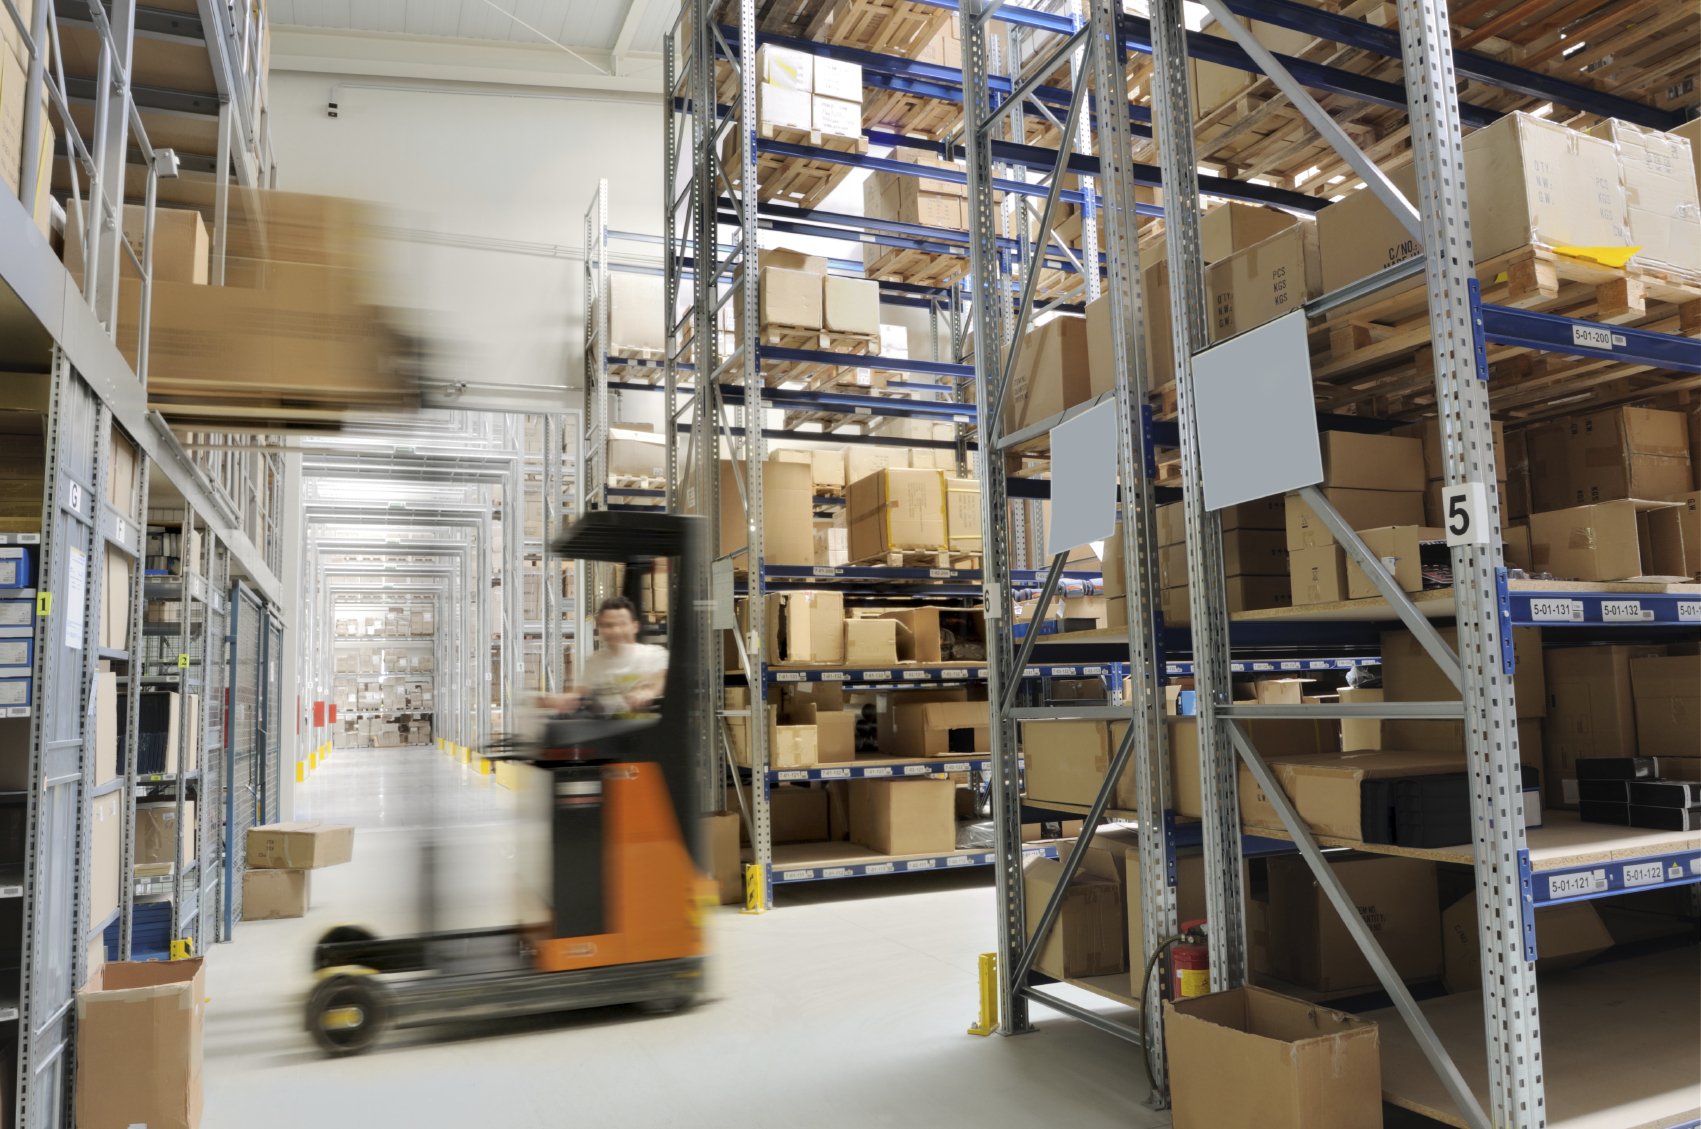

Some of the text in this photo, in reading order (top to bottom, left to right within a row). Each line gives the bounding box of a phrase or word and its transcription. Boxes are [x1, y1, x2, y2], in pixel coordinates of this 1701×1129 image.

[1272, 266, 1286, 280] PCS
[1273, 280, 1287, 293] KGS
[1274, 292, 1288, 305] KGS
[1575, 329, 1609, 344] 5-01-200
[1448, 493, 1470, 536] 5
[40, 597, 47, 611] 1
[984, 589, 991, 613] 6
[1533, 604, 1570, 615] 5-01-131
[1604, 605, 1639, 616] 5-01-132
[1626, 866, 1661, 881] 5-01-122
[1552, 877, 1590, 893] 5-01-121
